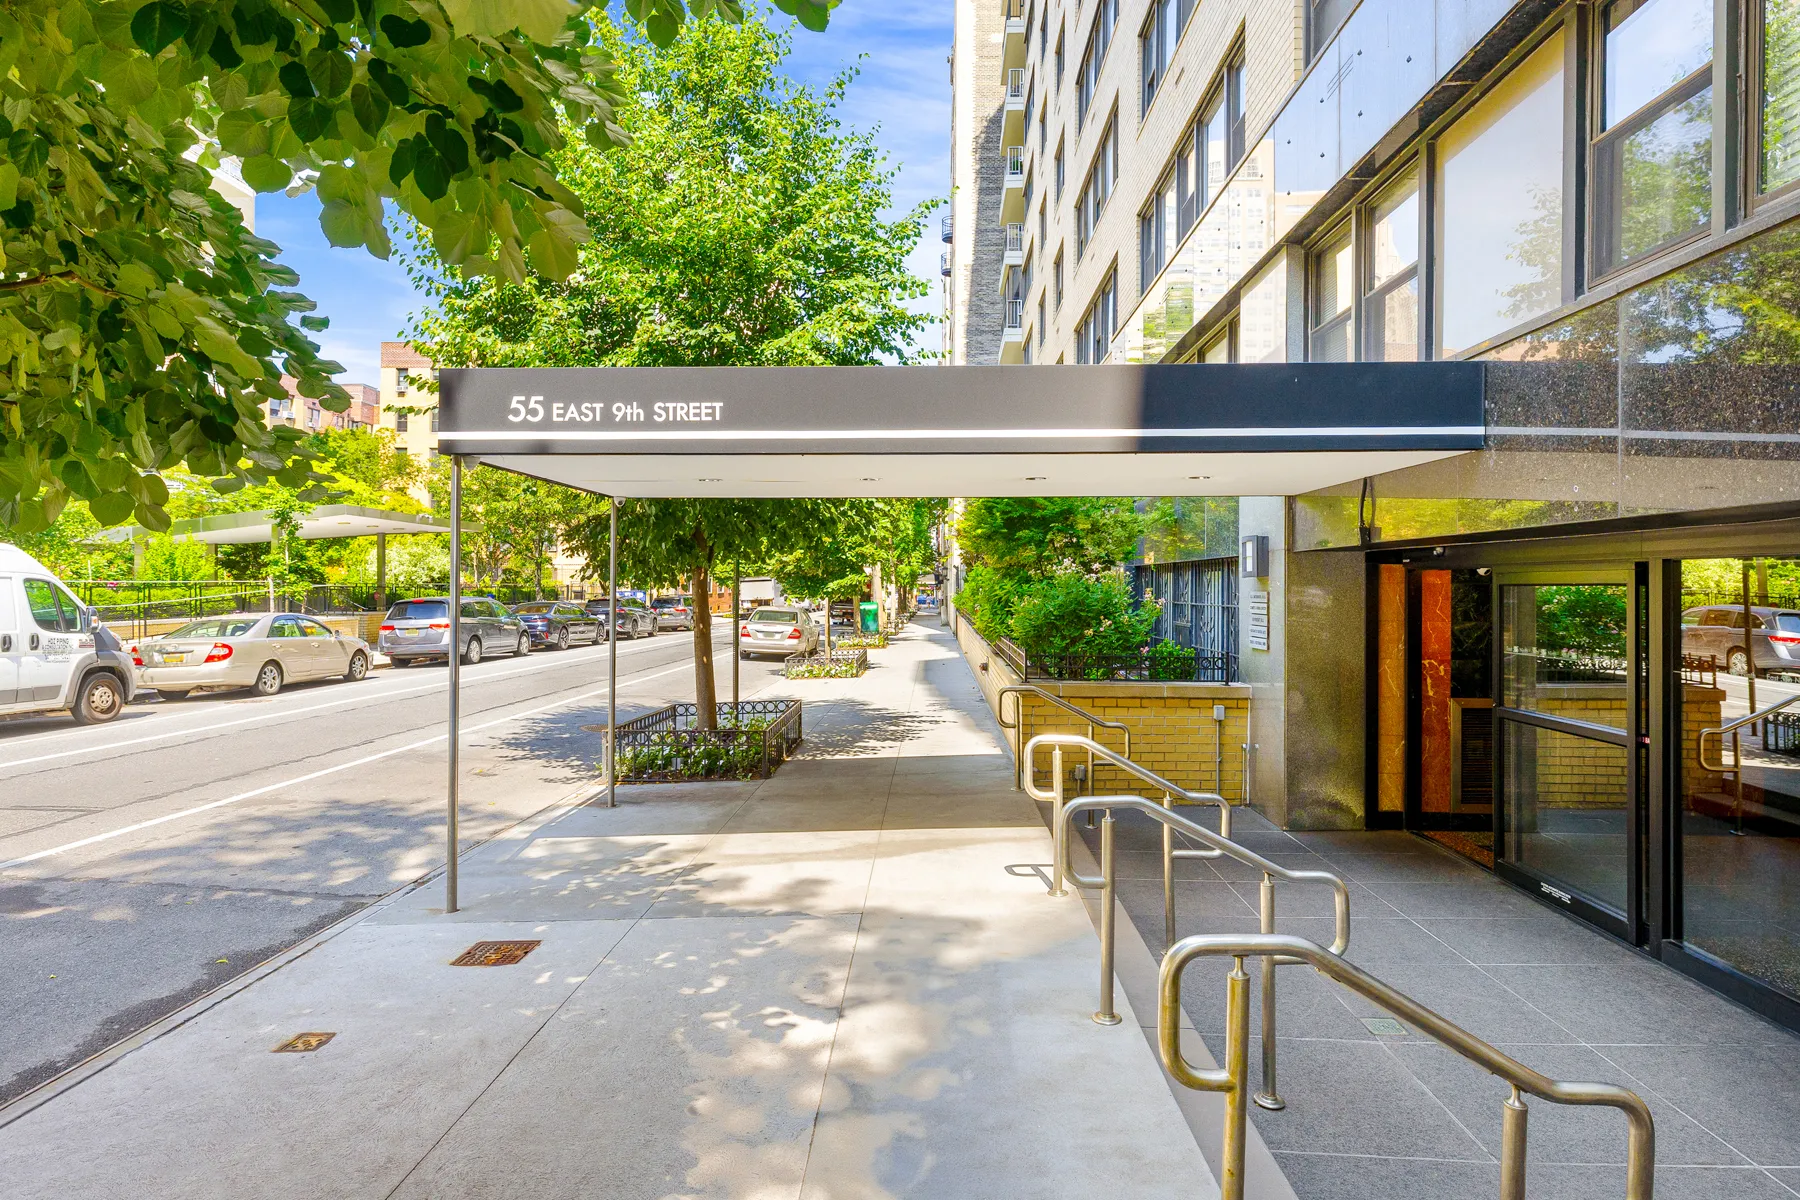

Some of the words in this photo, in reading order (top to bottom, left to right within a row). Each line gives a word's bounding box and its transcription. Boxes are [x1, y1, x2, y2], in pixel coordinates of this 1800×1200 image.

[508, 395, 544, 422] 55
[552, 403, 604, 422] EAST
[612, 402, 644, 422] 9th
[653, 402, 723, 422] STREET
